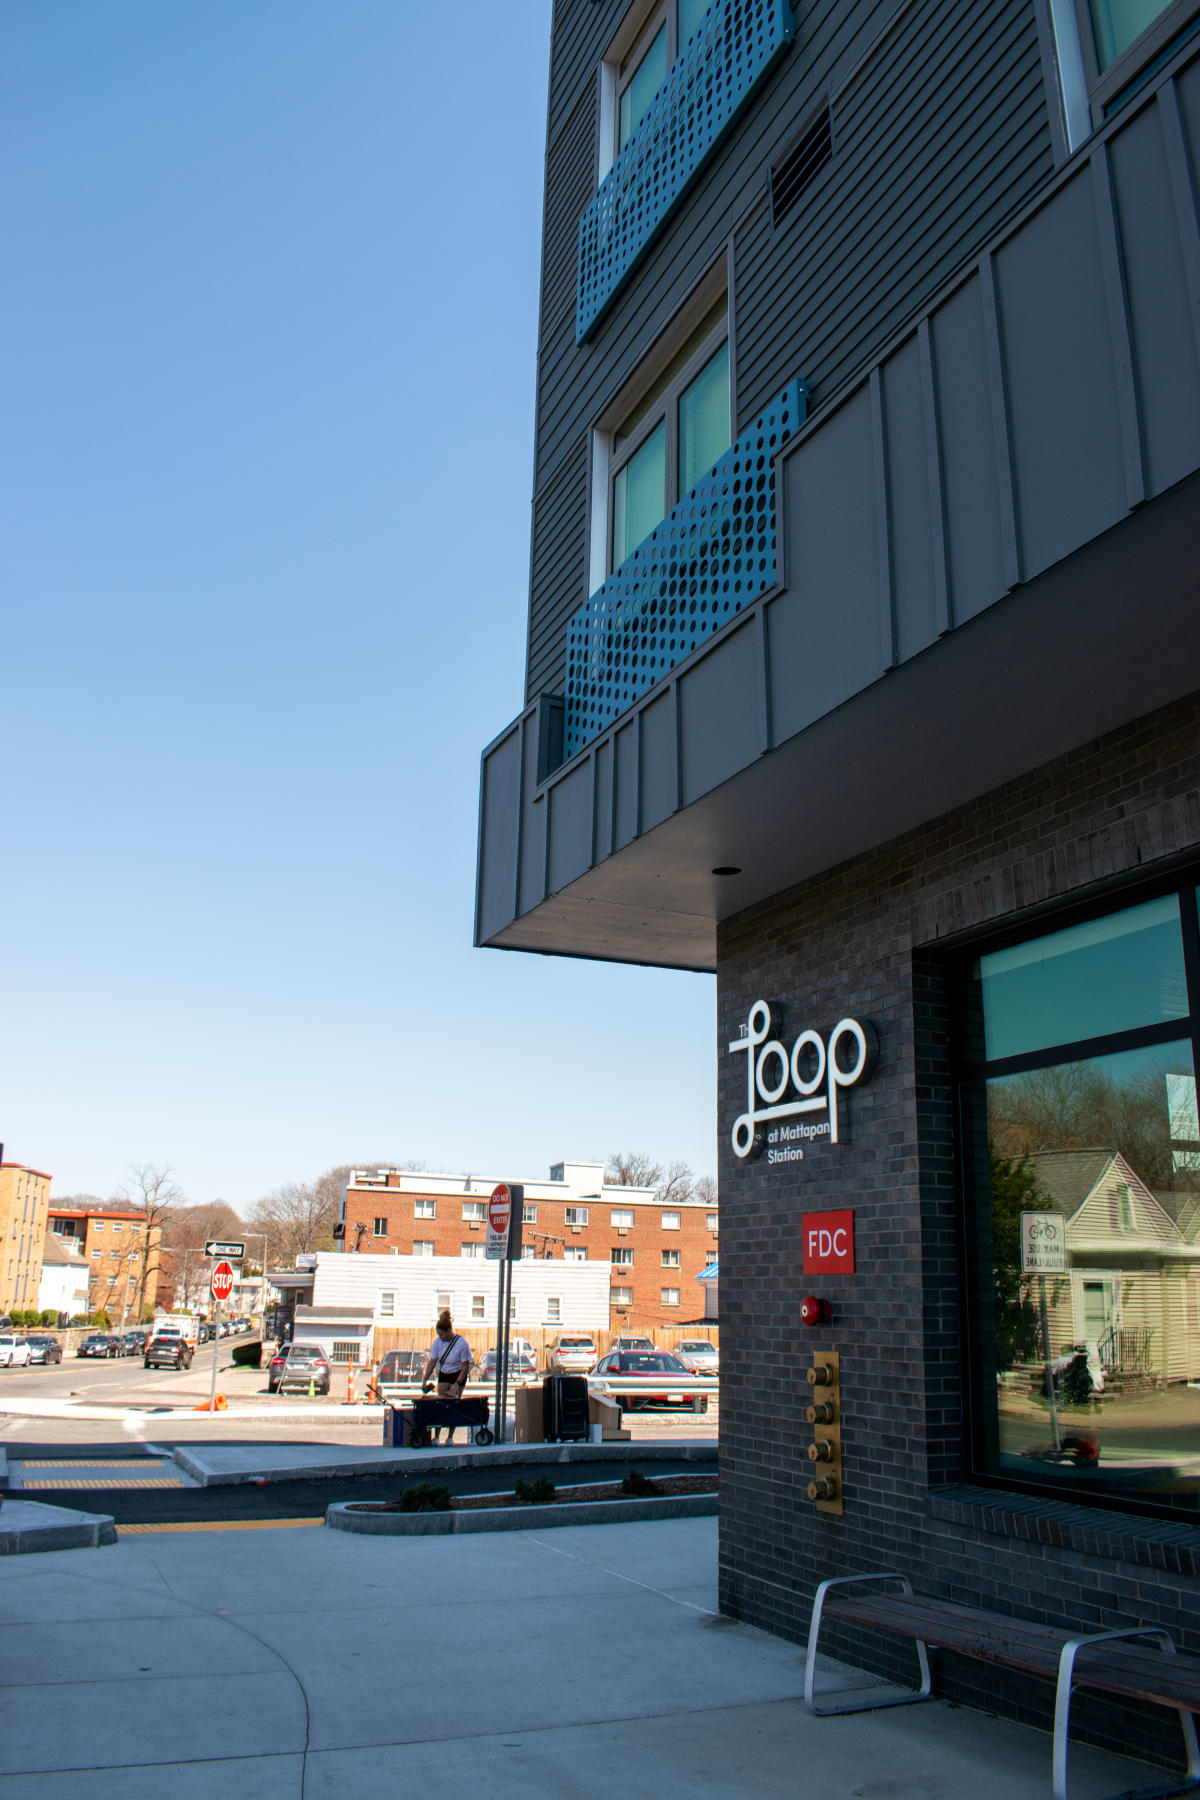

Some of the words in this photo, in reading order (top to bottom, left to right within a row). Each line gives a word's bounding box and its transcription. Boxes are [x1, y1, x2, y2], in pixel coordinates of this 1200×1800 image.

[729, 1000, 866, 1158] loop
[767, 1131, 778, 1143] at
[779, 1123, 830, 1141] Mattapan
[767, 1147, 804, 1165] Station
[493, 1216, 508, 1224] ENTER
[808, 1228, 848, 1257] FDC
[213, 1273, 233, 1289] STOP
